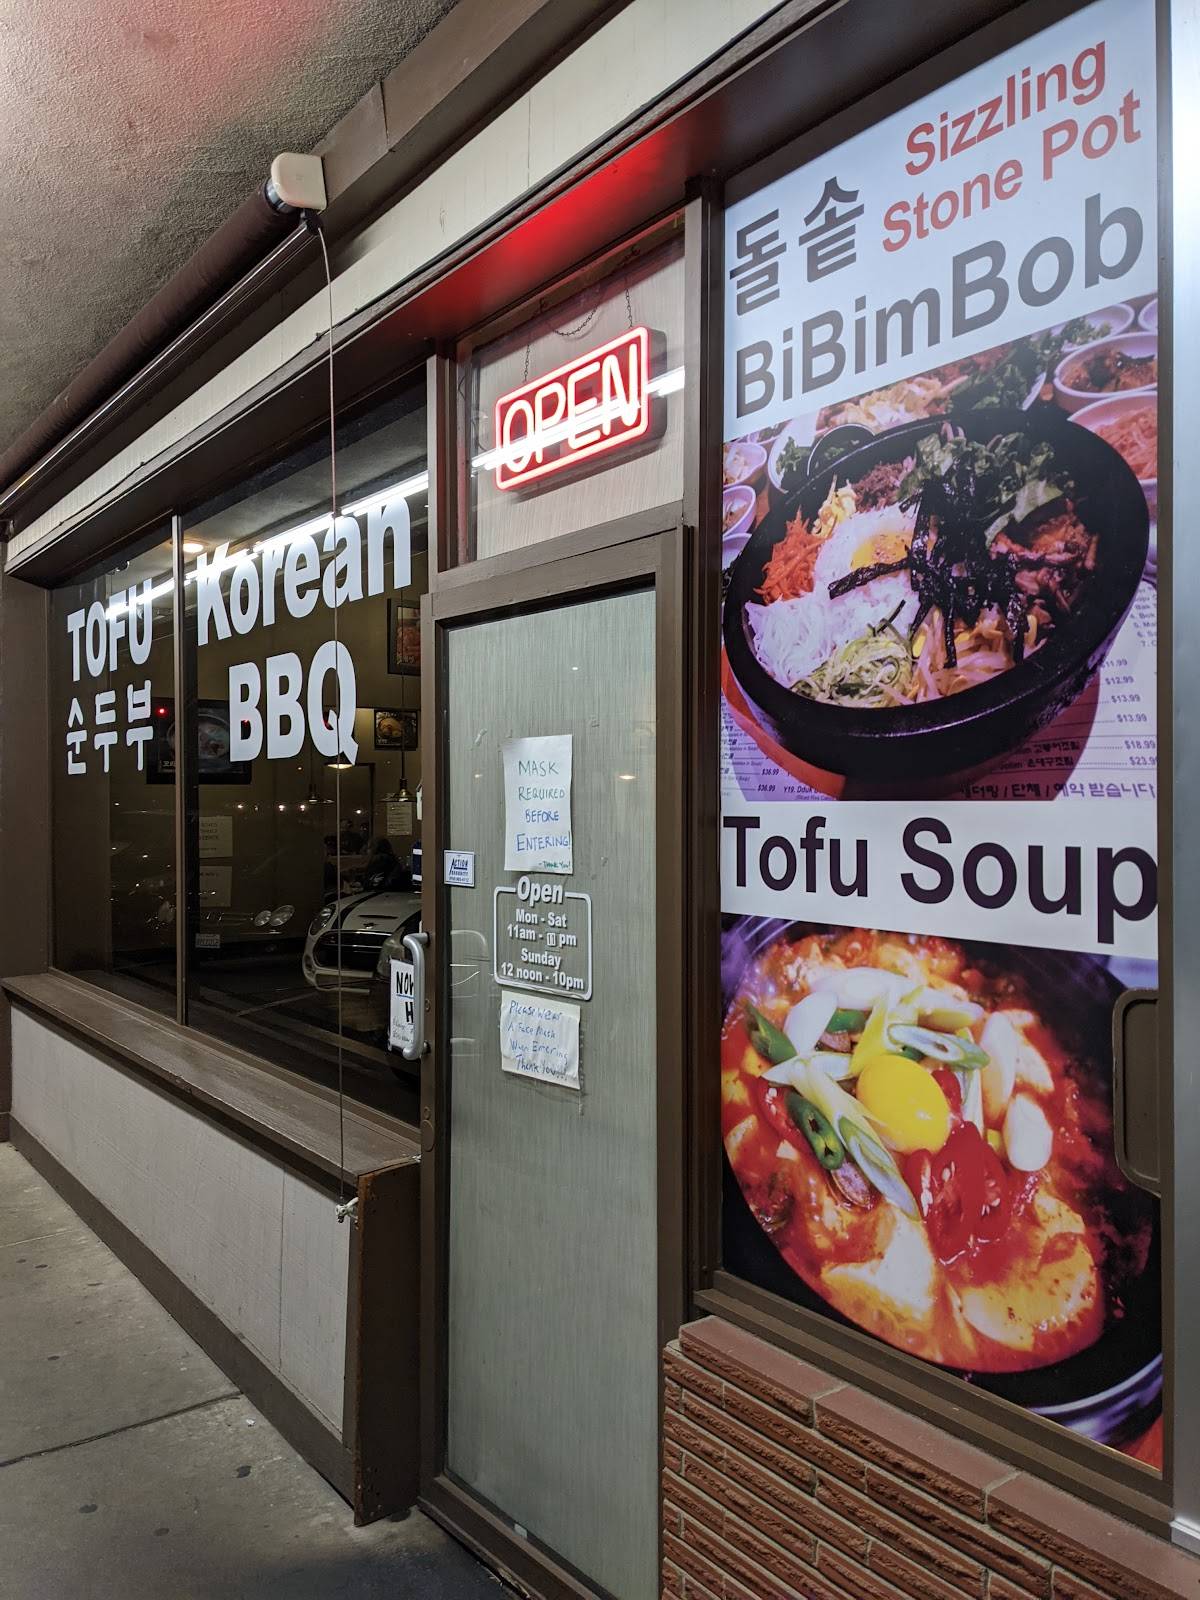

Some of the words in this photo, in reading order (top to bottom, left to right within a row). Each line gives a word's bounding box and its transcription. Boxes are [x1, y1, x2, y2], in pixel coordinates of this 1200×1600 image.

[905, 41, 1106, 177] Sizzling
[882, 159, 1023, 253] Stone
[1042, 88, 1141, 181] Pot
[736, 193, 1144, 419] BiBimBob
[502, 343, 639, 473] OPEN
[197, 494, 412, 646] Korean
[67, 578, 153, 682] TOFU
[66, 679, 154, 775] 순두부
[228, 640, 360, 766] BBQ
[518, 760, 559, 777] MASK
[518, 786, 565, 801] REQUIRED
[1088, 783, 1156, 798] 받습니다
[525, 809, 560, 823] BEFORE
[517, 875, 563, 907] Open
[723, 815, 868, 897] Tofu
[900, 817, 1159, 944] Soup
[507, 924, 536, 940] 11am
[560, 933, 577, 948] pm
[516, 908, 538, 924] Mon
[547, 912, 567, 927] Sat
[501, 962, 514, 976] 12
[516, 967, 543, 982] noon
[553, 970, 584, 990] 10pm
[521, 948, 561, 970] Sunday
